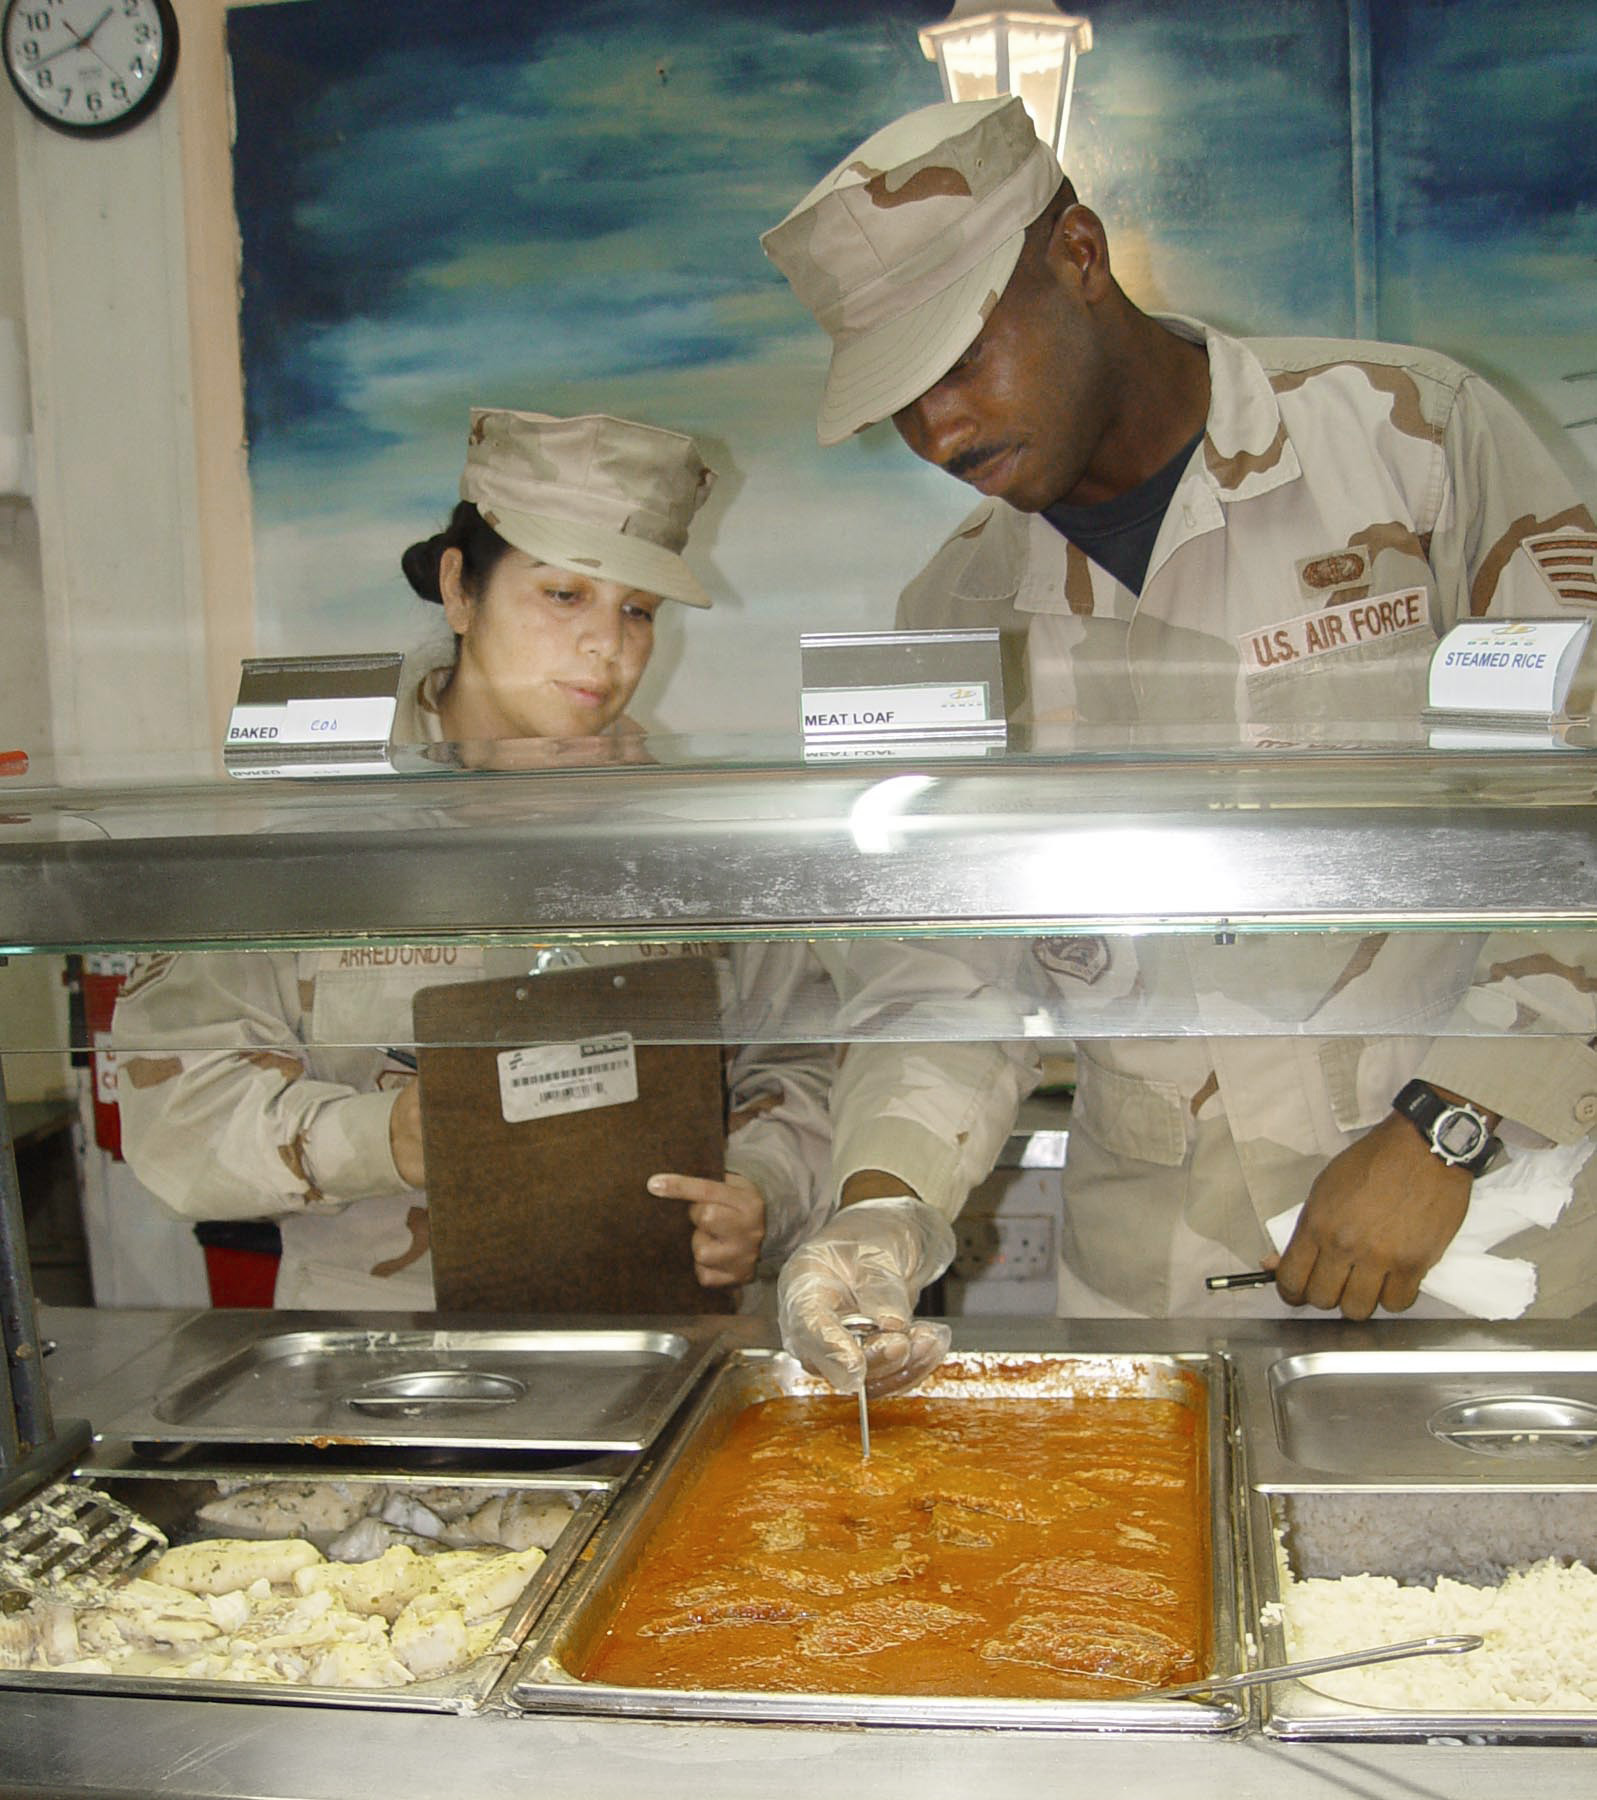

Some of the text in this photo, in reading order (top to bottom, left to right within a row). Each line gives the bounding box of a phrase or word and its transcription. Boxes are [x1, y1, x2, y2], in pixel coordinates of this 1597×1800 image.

[27, 11, 50, 31] 10
[135, 23, 149, 44] 3
[23, 40, 38, 61] 9
[36, 69, 52, 89] 8
[110, 79, 127, 99] 5
[59, 87, 71, 106] 7
[86, 92, 102, 111] 6
[1252, 594, 1420, 667] U.S. AIR FORCE
[1445, 652, 1546, 669] STEAMED RICE
[804, 711, 895, 726] MEAT LOAF
[230, 727, 279, 739] BAKED
